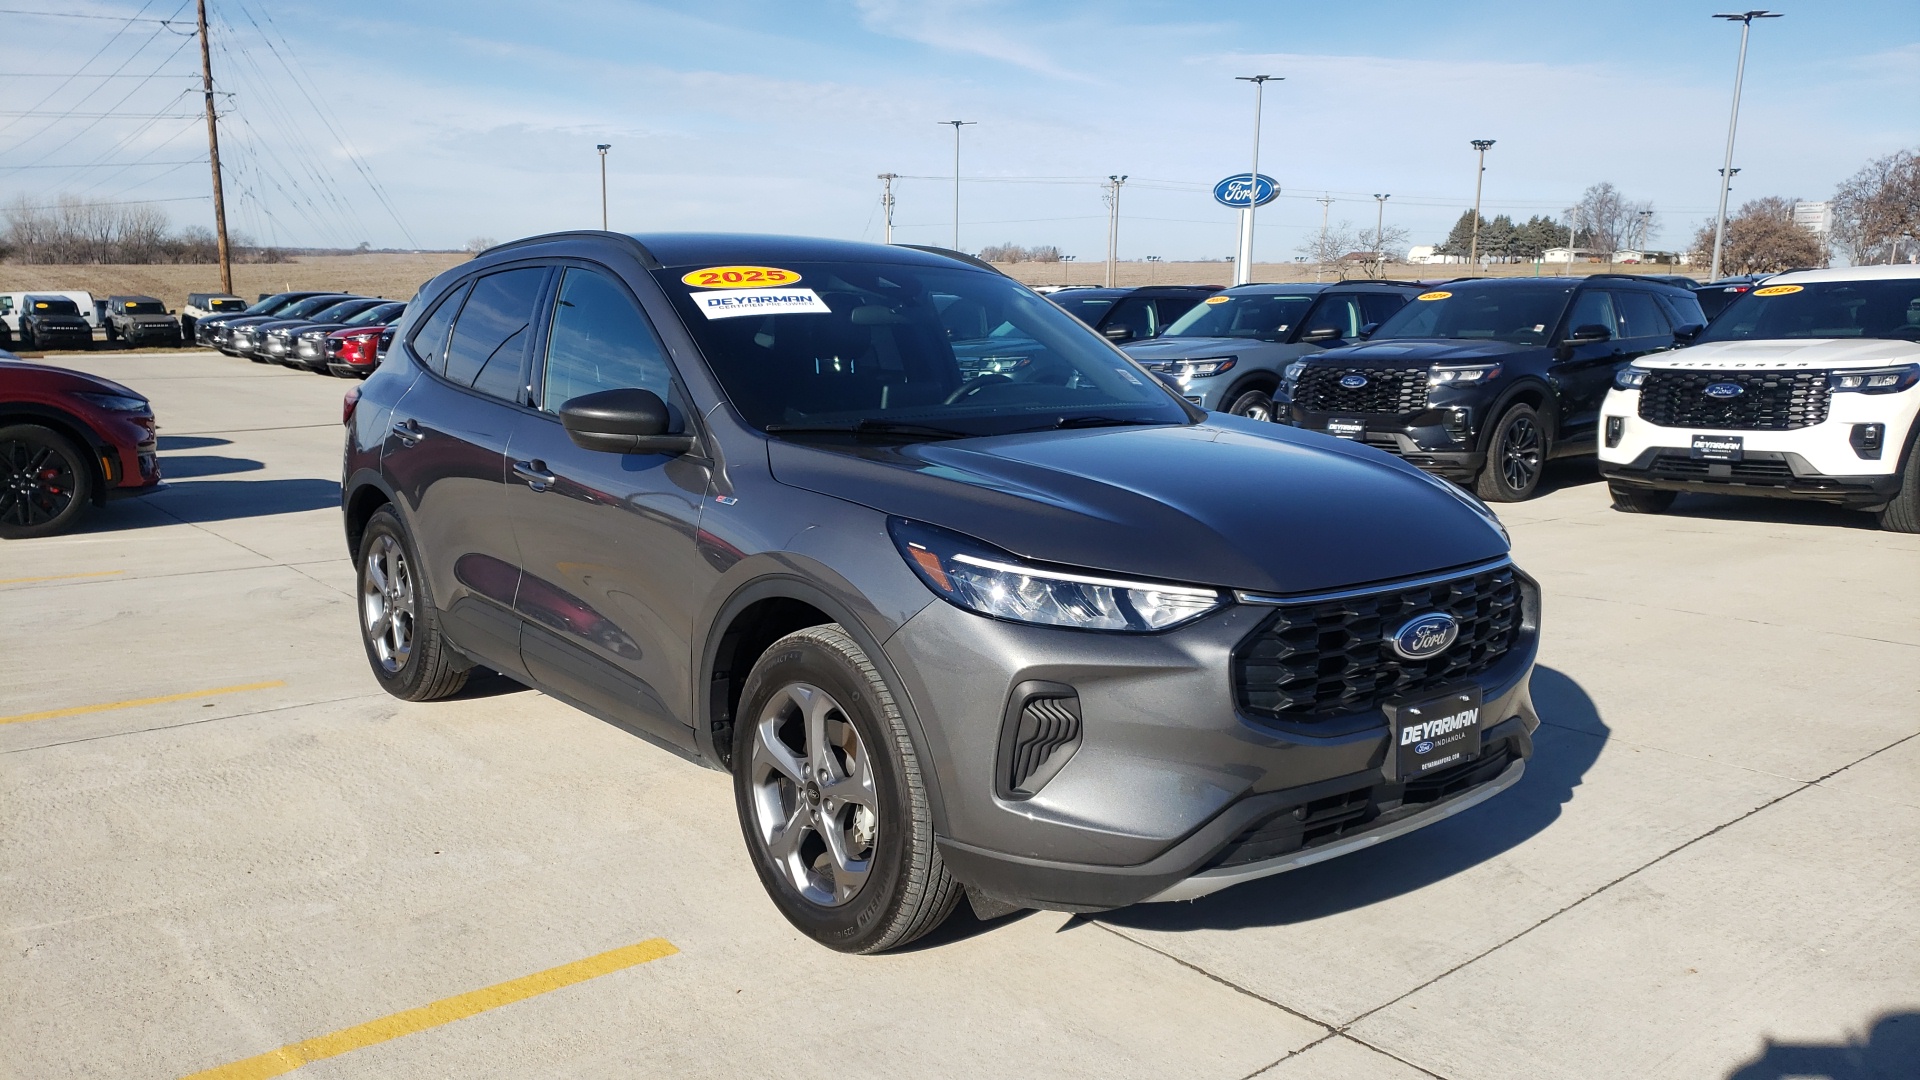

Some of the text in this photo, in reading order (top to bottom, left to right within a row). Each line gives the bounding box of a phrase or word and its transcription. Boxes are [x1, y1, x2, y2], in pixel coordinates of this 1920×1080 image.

[1224, 180, 1263, 201] Ford
[699, 270, 787, 285] 2025
[707, 295, 813, 307] DEYARMAN
[1693, 440, 1740, 450] DEYARMAN
[1412, 624, 1447, 651] Ford
[1400, 707, 1479, 746] DEYARMAN
[1434, 731, 1466, 748] INDIANOLA
